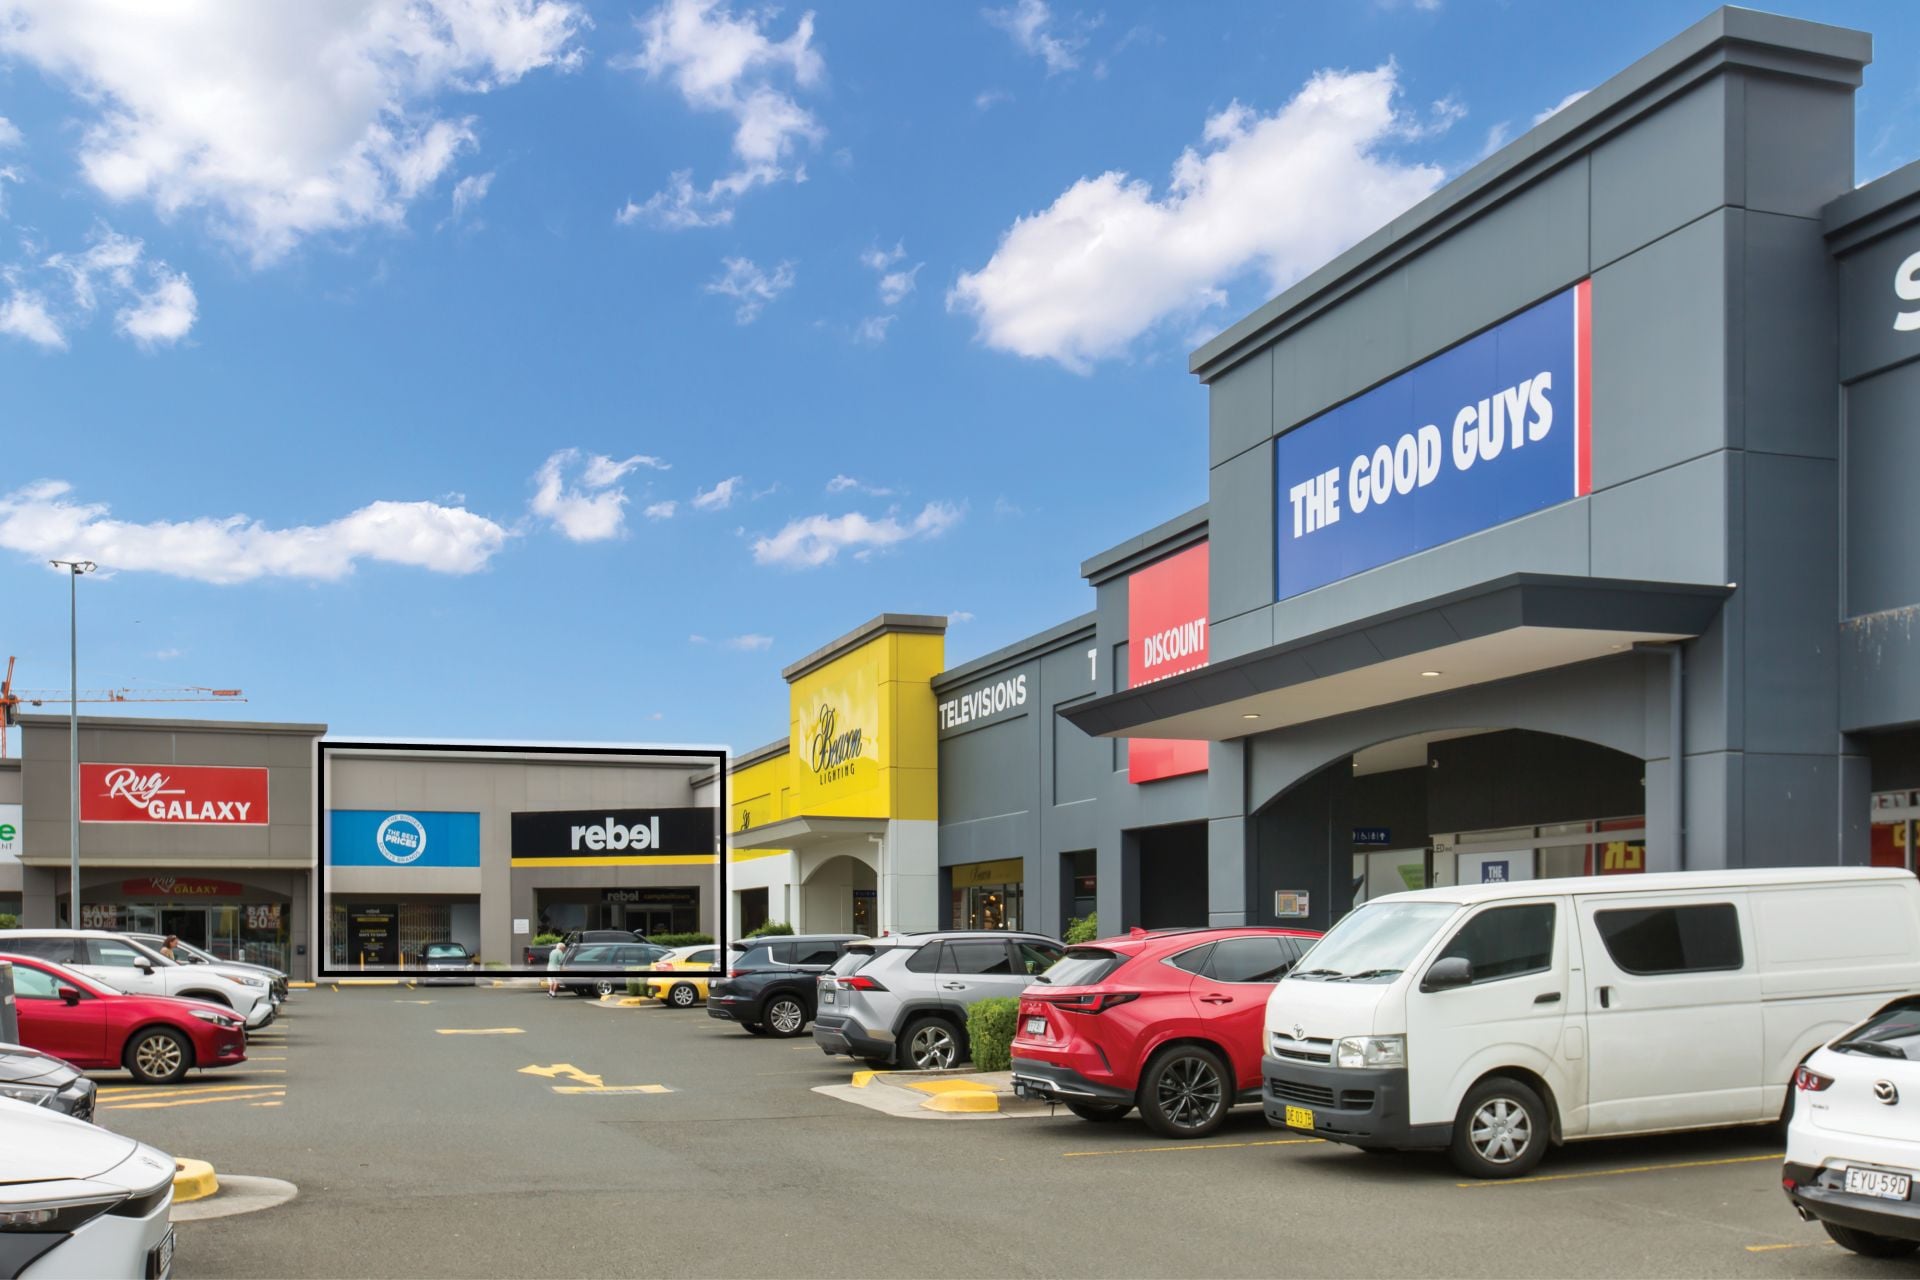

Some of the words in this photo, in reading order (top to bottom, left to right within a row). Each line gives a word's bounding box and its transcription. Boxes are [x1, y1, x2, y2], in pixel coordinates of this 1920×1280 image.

[1290, 467, 1339, 538] THE
[1348, 424, 1442, 514] GOOD
[1452, 371, 1553, 471] GUYS
[1143, 617, 1206, 669] DISCOUNT
[939, 674, 1027, 730] TELEVISIONS
[812, 703, 863, 774] Beacon
[819, 763, 855, 786] LIGHTING
[103, 768, 174, 809] Rug
[148, 800, 251, 821] GALAXY
[385, 834, 417, 848] PRICES
[387, 828, 400, 838] THE
[401, 832, 418, 841] BEST
[571, 816, 660, 850] rebel
[1488, 865, 1503, 879] THE
[173, 885, 218, 894] GALAXY
[607, 890, 640, 901] rebel
[82, 904, 117, 915] SALE
[247, 904, 281, 916] SALE
